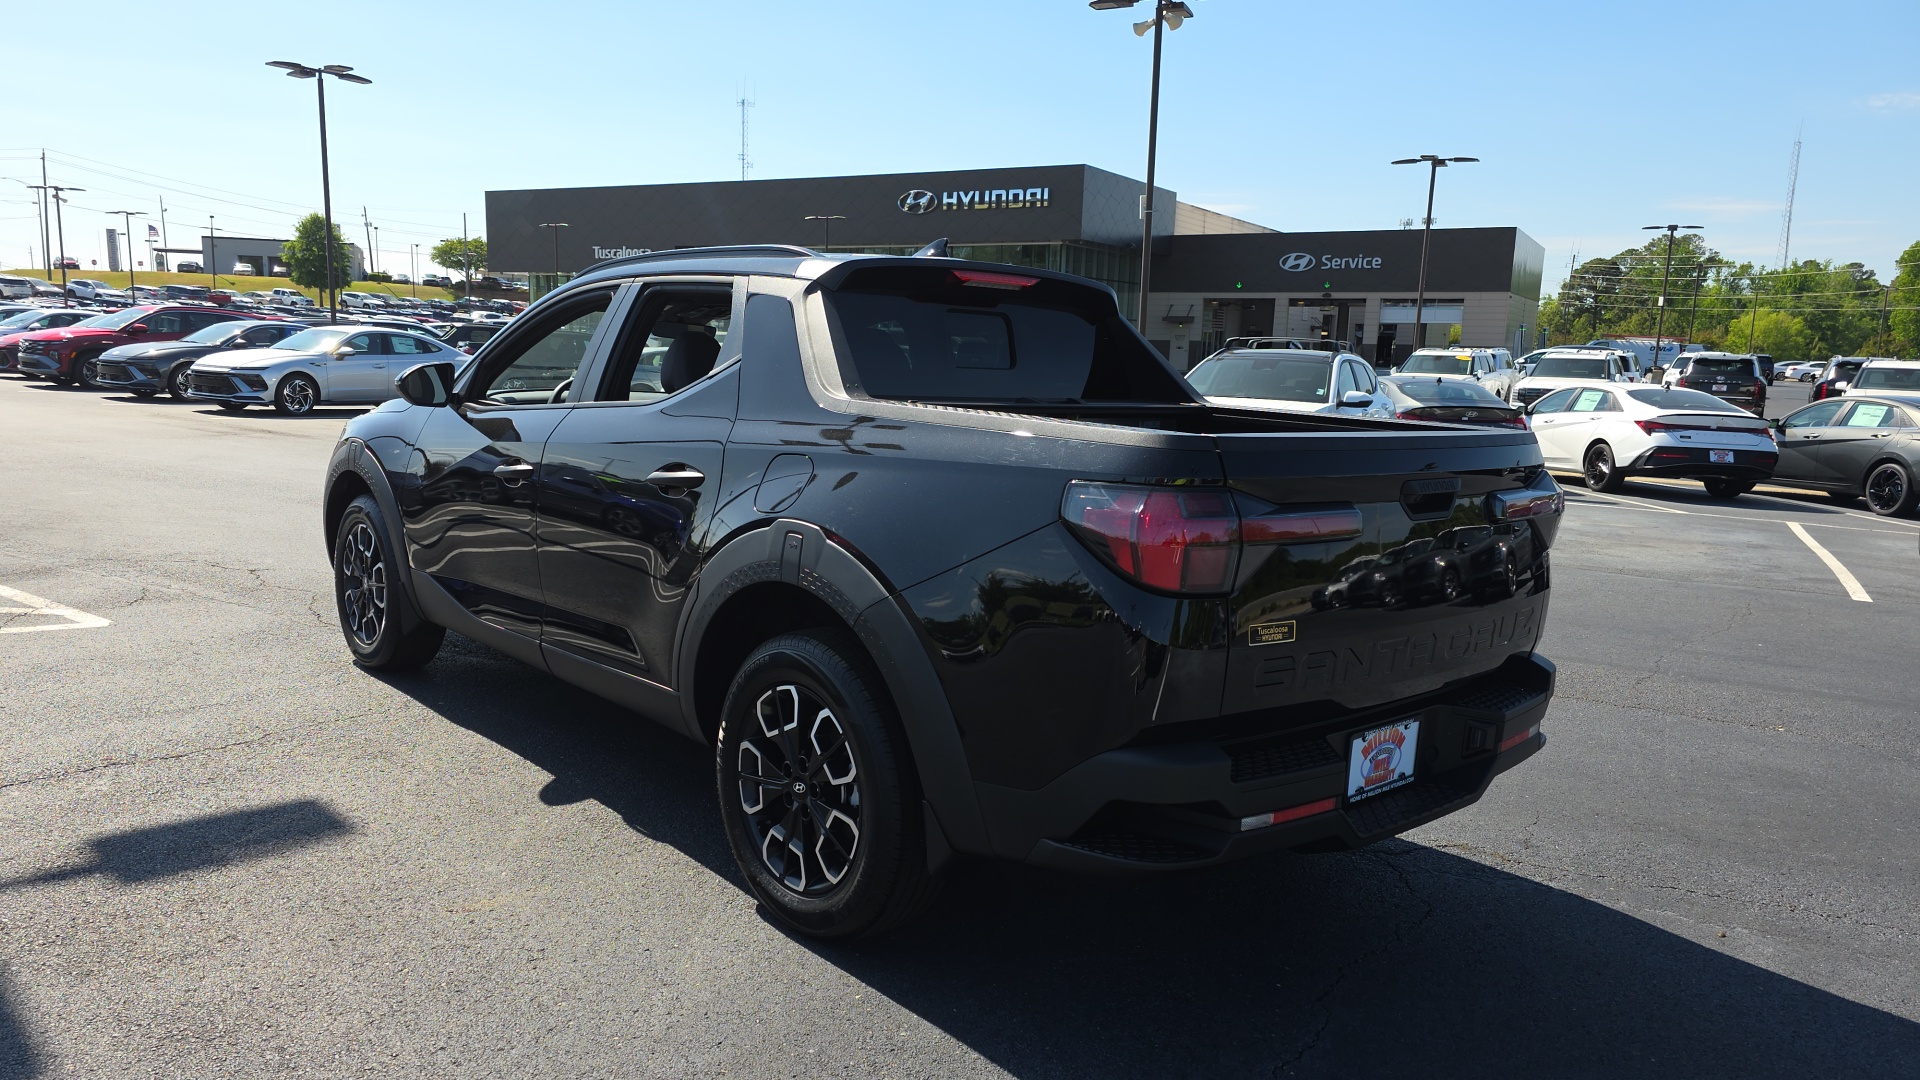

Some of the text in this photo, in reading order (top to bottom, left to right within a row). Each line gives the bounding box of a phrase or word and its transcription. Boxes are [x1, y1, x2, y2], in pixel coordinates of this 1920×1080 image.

[942, 187, 1050, 211] HYUNDAI
[592, 245, 652, 259] Tuscaloosa
[1320, 253, 1382, 270] Service
[1418, 480, 1456, 493] HYUNDAI
[1257, 625, 1289, 635] Tuscaloosa
[1261, 633, 1283, 642] HYUNDAI
[1253, 607, 1535, 696] SANTA CRUZ
[1361, 728, 1406, 760] MILLION
[1373, 755, 1391, 773] MILE
[1350, 795, 1361, 803] HOME
